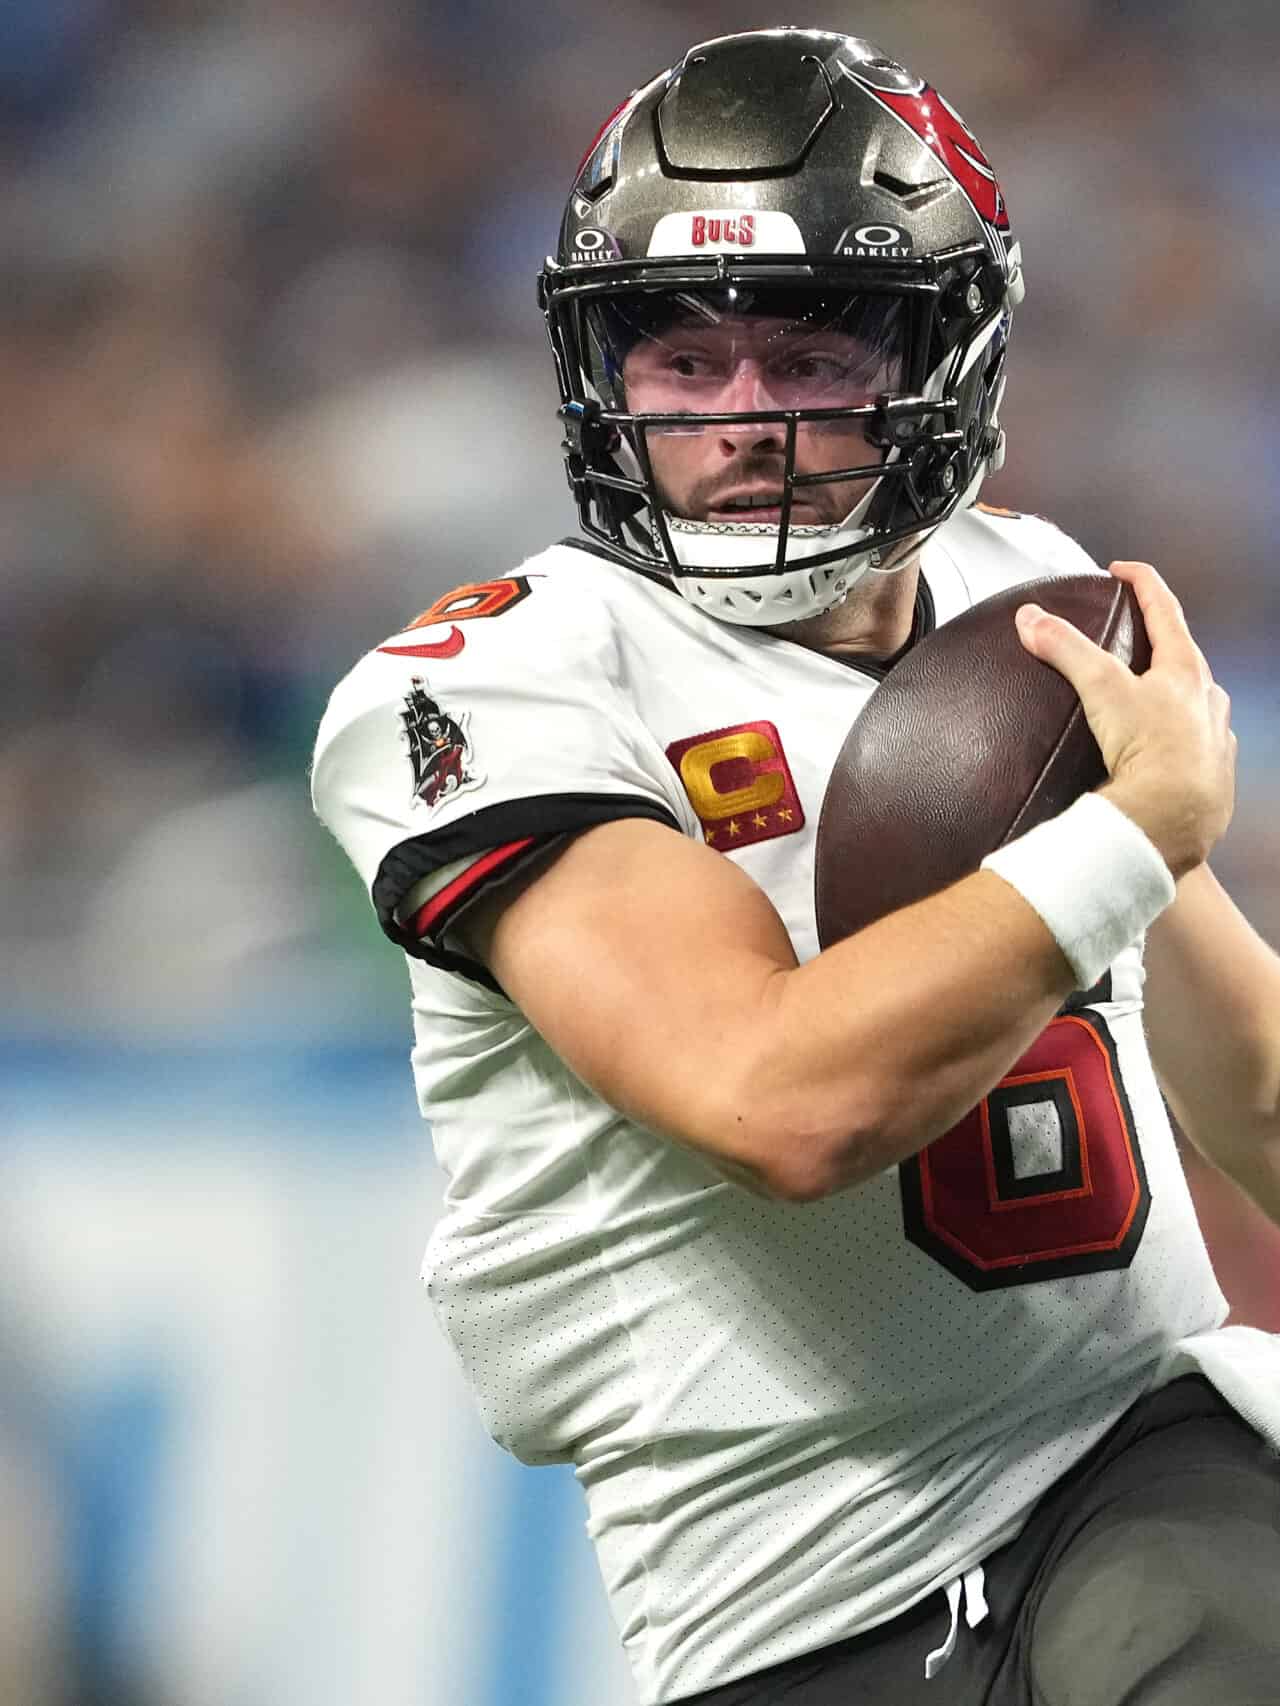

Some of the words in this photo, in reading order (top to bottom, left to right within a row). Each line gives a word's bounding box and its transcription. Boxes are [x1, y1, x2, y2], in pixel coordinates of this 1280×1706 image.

[691, 214, 756, 247] BUCS
[843, 247, 909, 257] OAKLEY
[679, 730, 786, 821] C
